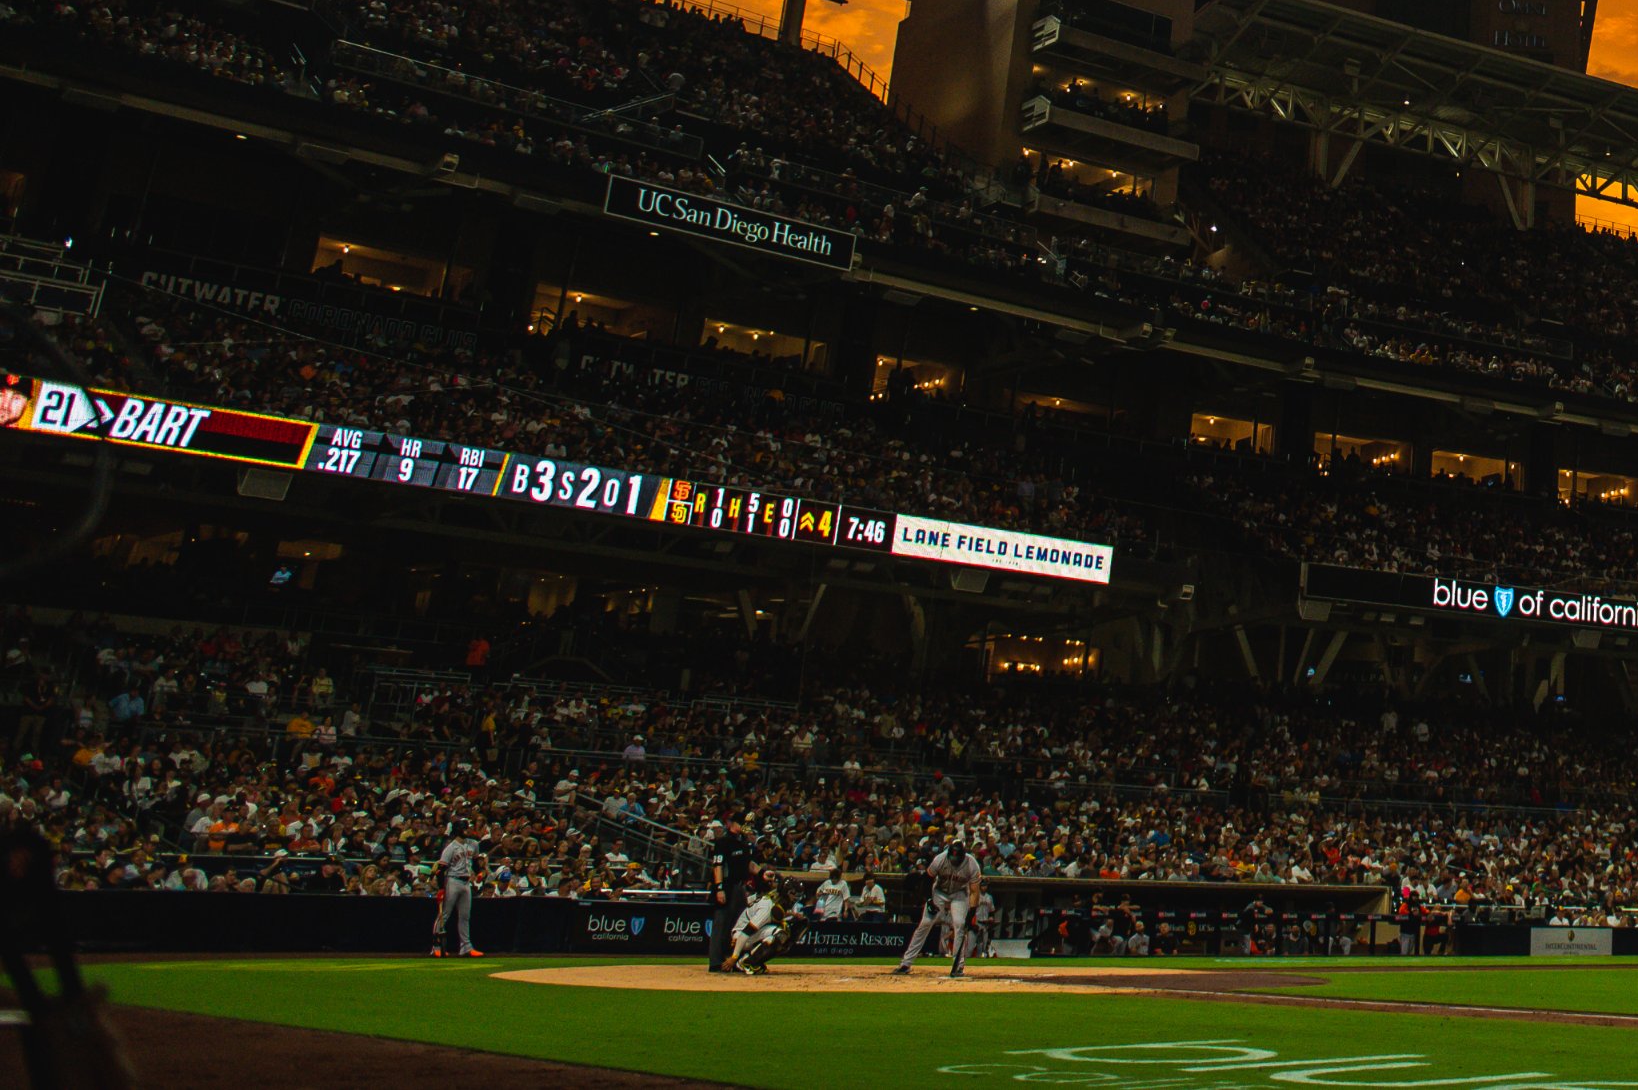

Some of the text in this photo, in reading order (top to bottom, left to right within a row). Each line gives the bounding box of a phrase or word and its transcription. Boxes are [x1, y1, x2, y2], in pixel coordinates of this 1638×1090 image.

[637, 188, 833, 256] UC San Diego Health
[38, 390, 77, 427] 21
[109, 397, 212, 448] BART
[331, 428, 363, 450] AVG
[400, 438, 423, 458] HR
[316, 449, 362, 474] .217
[459, 447, 485, 468] RBI
[397, 457, 415, 483] 9
[457, 466, 480, 491] 17
[511, 463, 531, 493] B
[531, 459, 557, 502] 3
[557, 471, 576, 501] S
[575, 467, 602, 509] 2
[626, 474, 643, 515] 1
[715, 487, 726, 508] 1
[693, 492, 707, 513] R
[727, 497, 742, 518] H
[748, 492, 761, 513] 5
[782, 498, 794, 518] 0
[710, 508, 724, 528] 0
[746, 513, 756, 534] 1
[763, 503, 776, 524] E
[817, 510, 833, 538] 4
[778, 518, 791, 538] 0
[846, 514, 887, 544] 7:46
[902, 526, 952, 548] LANE
[957, 535, 1009, 556] FIELD
[1013, 542, 1105, 571] LEMONADE
[1432, 578, 1489, 612] blue
[1518, 591, 1544, 618] of
[587, 914, 627, 932] blue
[664, 916, 701, 934] blue
[592, 932, 629, 941] california
[668, 934, 703, 942] california
[806, 930, 905, 946] HOTELS & RESORTS
